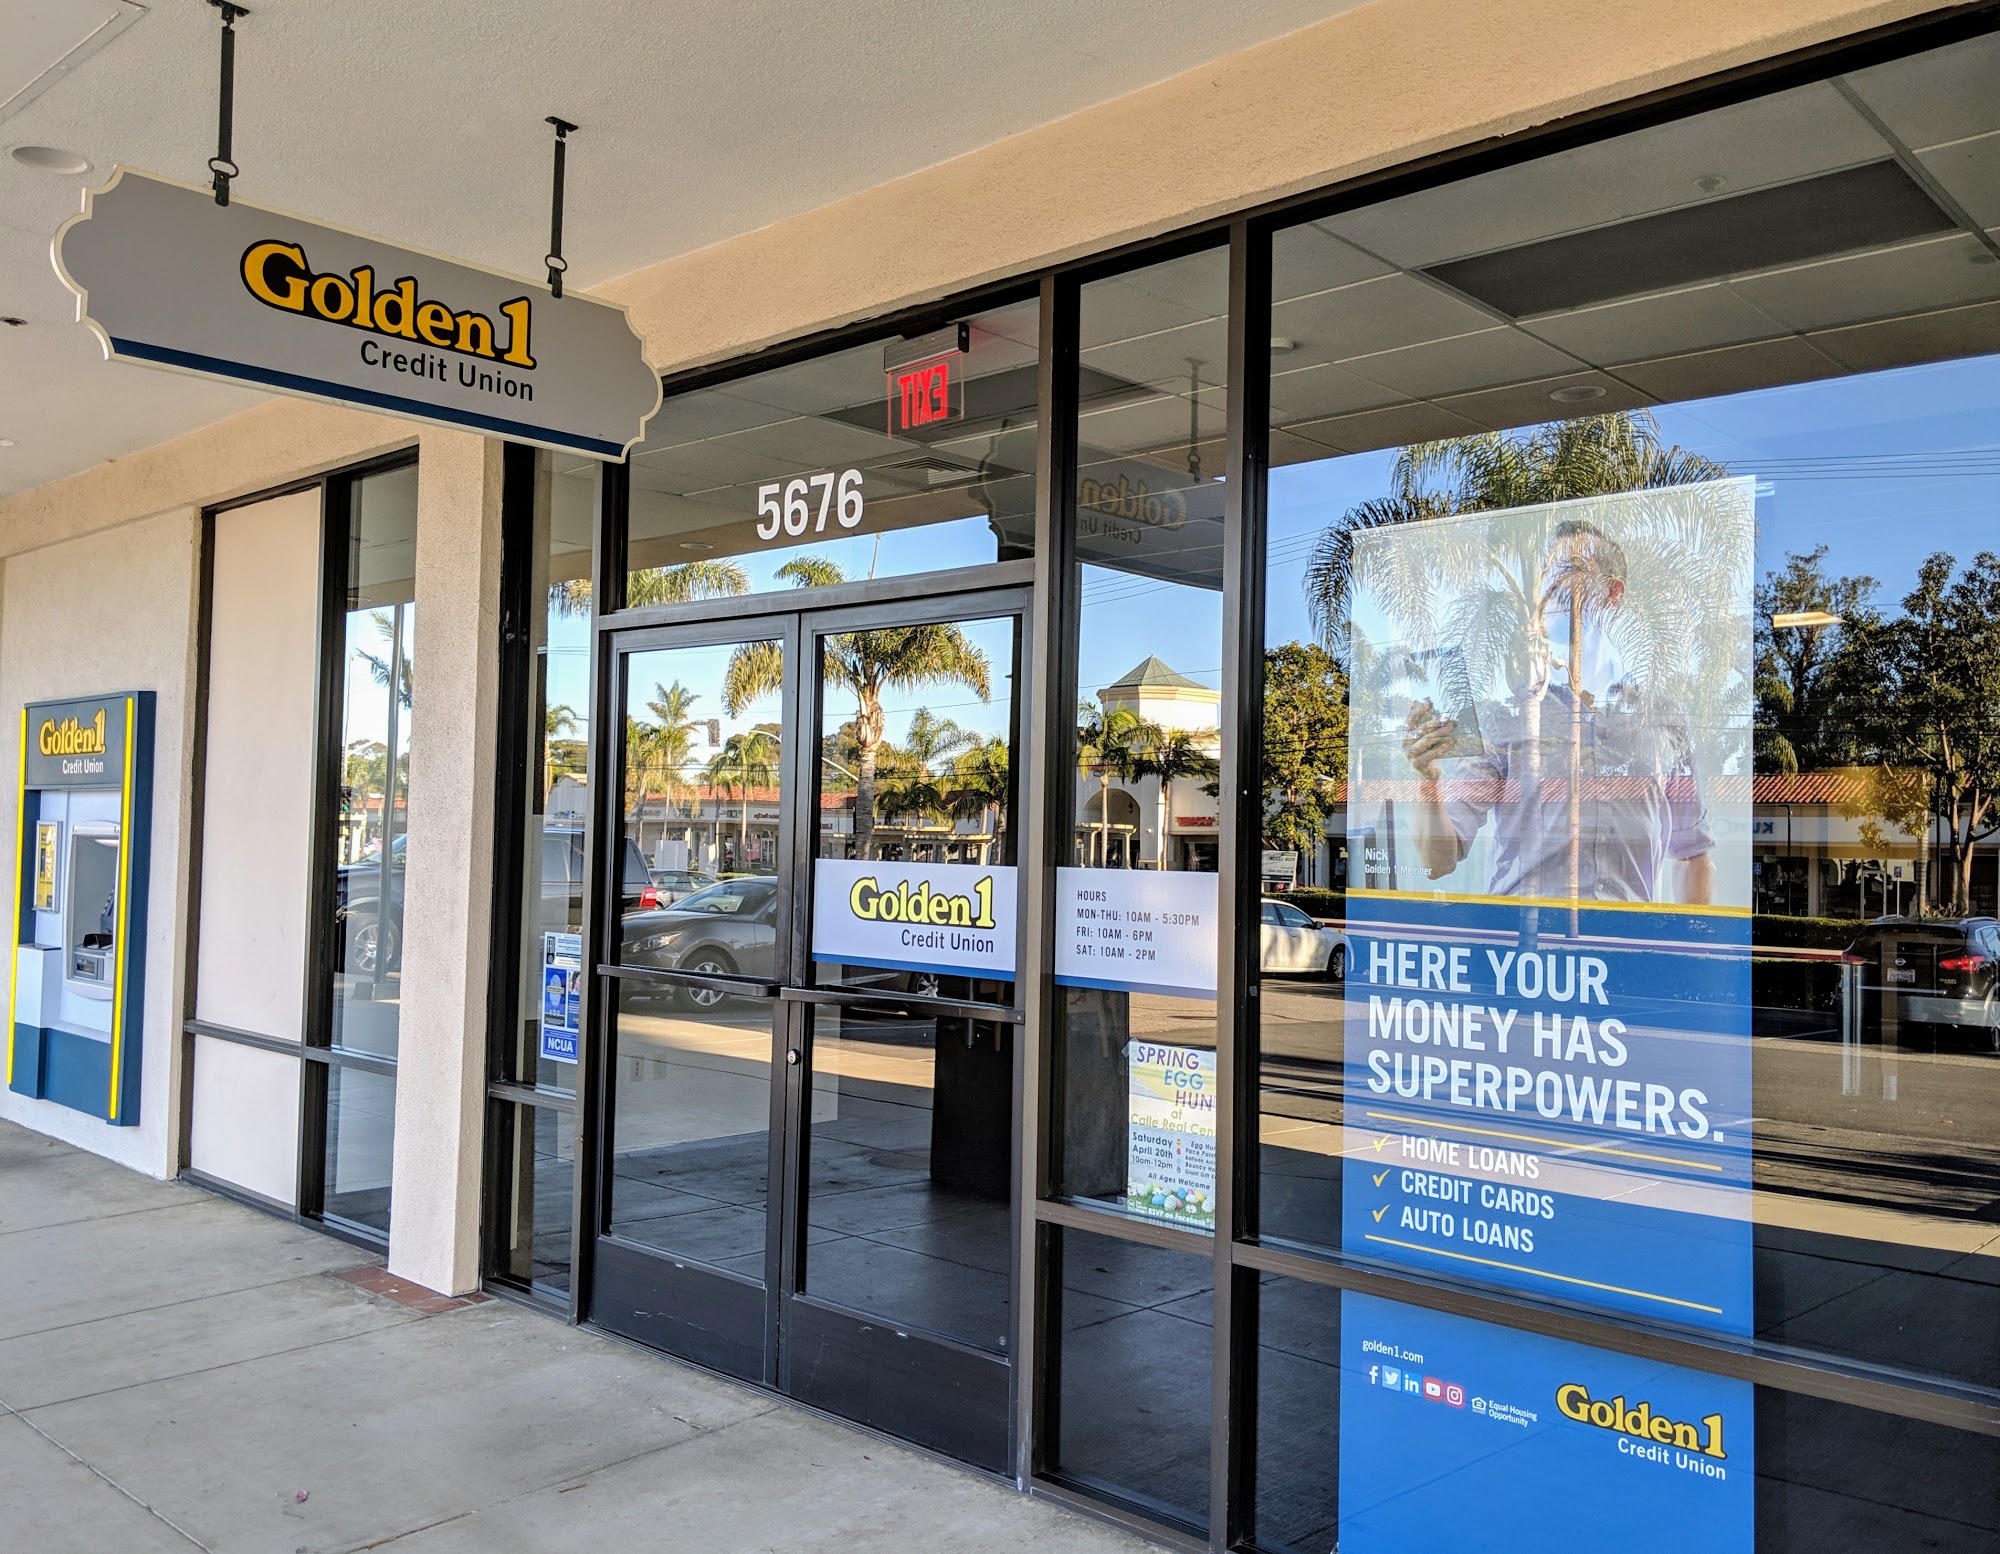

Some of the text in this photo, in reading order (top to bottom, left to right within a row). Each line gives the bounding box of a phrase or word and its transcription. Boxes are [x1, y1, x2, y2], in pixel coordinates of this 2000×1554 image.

[360, 340, 534, 402] Credit Union
[756, 469, 864, 540] 5676
[62, 758, 104, 775] Credit Union
[1365, 848, 1388, 861] Nick
[1364, 864, 1391, 874] Golden
[1400, 866, 1432, 876] Member
[1077, 890, 1107, 903] HOURS
[1076, 908, 1121, 923] MON-THU:
[1125, 911, 1151, 924] 10AM
[1162, 912, 1200, 926] 5:30PM
[901, 929, 995, 954] Credit Union
[1076, 926, 1093, 938] FRI:
[1097, 927, 1122, 940] 10AM
[1132, 929, 1153, 942] 6PM
[1076, 944, 1096, 957] SAT:
[1099, 946, 1124, 959] 10AM
[1135, 948, 1156, 961] 2PM
[1368, 941, 1609, 1006] HERE YOUR
[1368, 995, 1628, 1067] MONEY HAS
[547, 1036, 574, 1053] NCUA
[1136, 1045, 1200, 1070] SPRING
[1164, 1069, 1204, 1091] EGG
[1175, 1090, 1216, 1112] HUN
[1366, 1049, 1724, 1143] SUPERPOWERS.
[1171, 1110, 1182, 1120] at
[1131, 1113, 1216, 1138] Calle Real Cen
[1132, 1132, 1173, 1148] Saturday
[1190, 1141, 1203, 1150] Egg
[1132, 1144, 1173, 1159] April 20th
[1185, 1148, 1200, 1156] Face
[1402, 1135, 1540, 1179] HOME LOANS
[1132, 1155, 1173, 1170] 10am-12pm
[1159, 1175, 1176, 1183] Ages
[1178, 1178, 1211, 1190] Welcome
[1401, 1170, 1555, 1220] CREDIT CARDS
[1400, 1205, 1534, 1253] AUTO LOANS
[1362, 1339, 1424, 1365] golden1.com
[1488, 1400, 1538, 1422] Equal Housing
[1488, 1409, 1529, 1428] Opportunity
[1617, 1437, 1727, 1481] Credit Union
